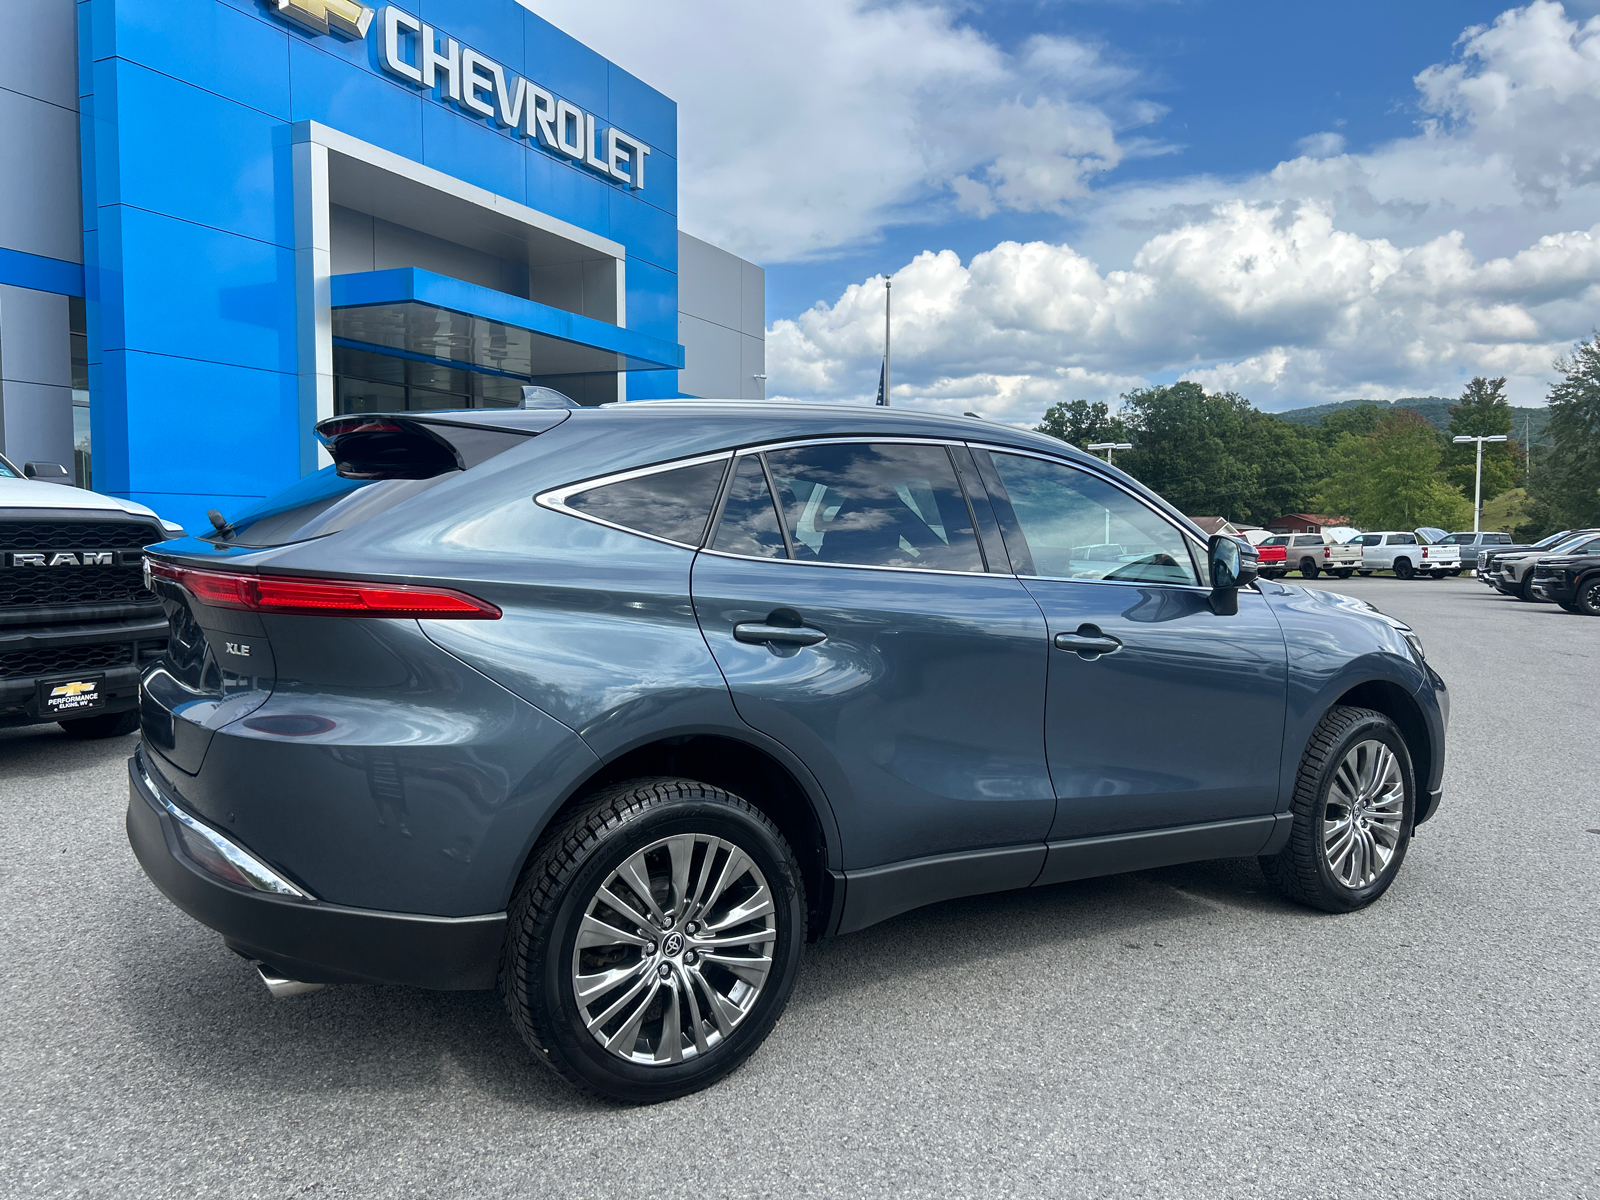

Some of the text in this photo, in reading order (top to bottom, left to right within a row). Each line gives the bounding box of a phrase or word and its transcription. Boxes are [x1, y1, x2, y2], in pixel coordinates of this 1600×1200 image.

[378, 5, 651, 190] CHEVROLET
[13, 552, 113, 567] RAM
[225, 641, 250, 656] XLE
[48, 692, 98, 705] PERFORMANCE
[572, 841, 624, 898] GENERAL
